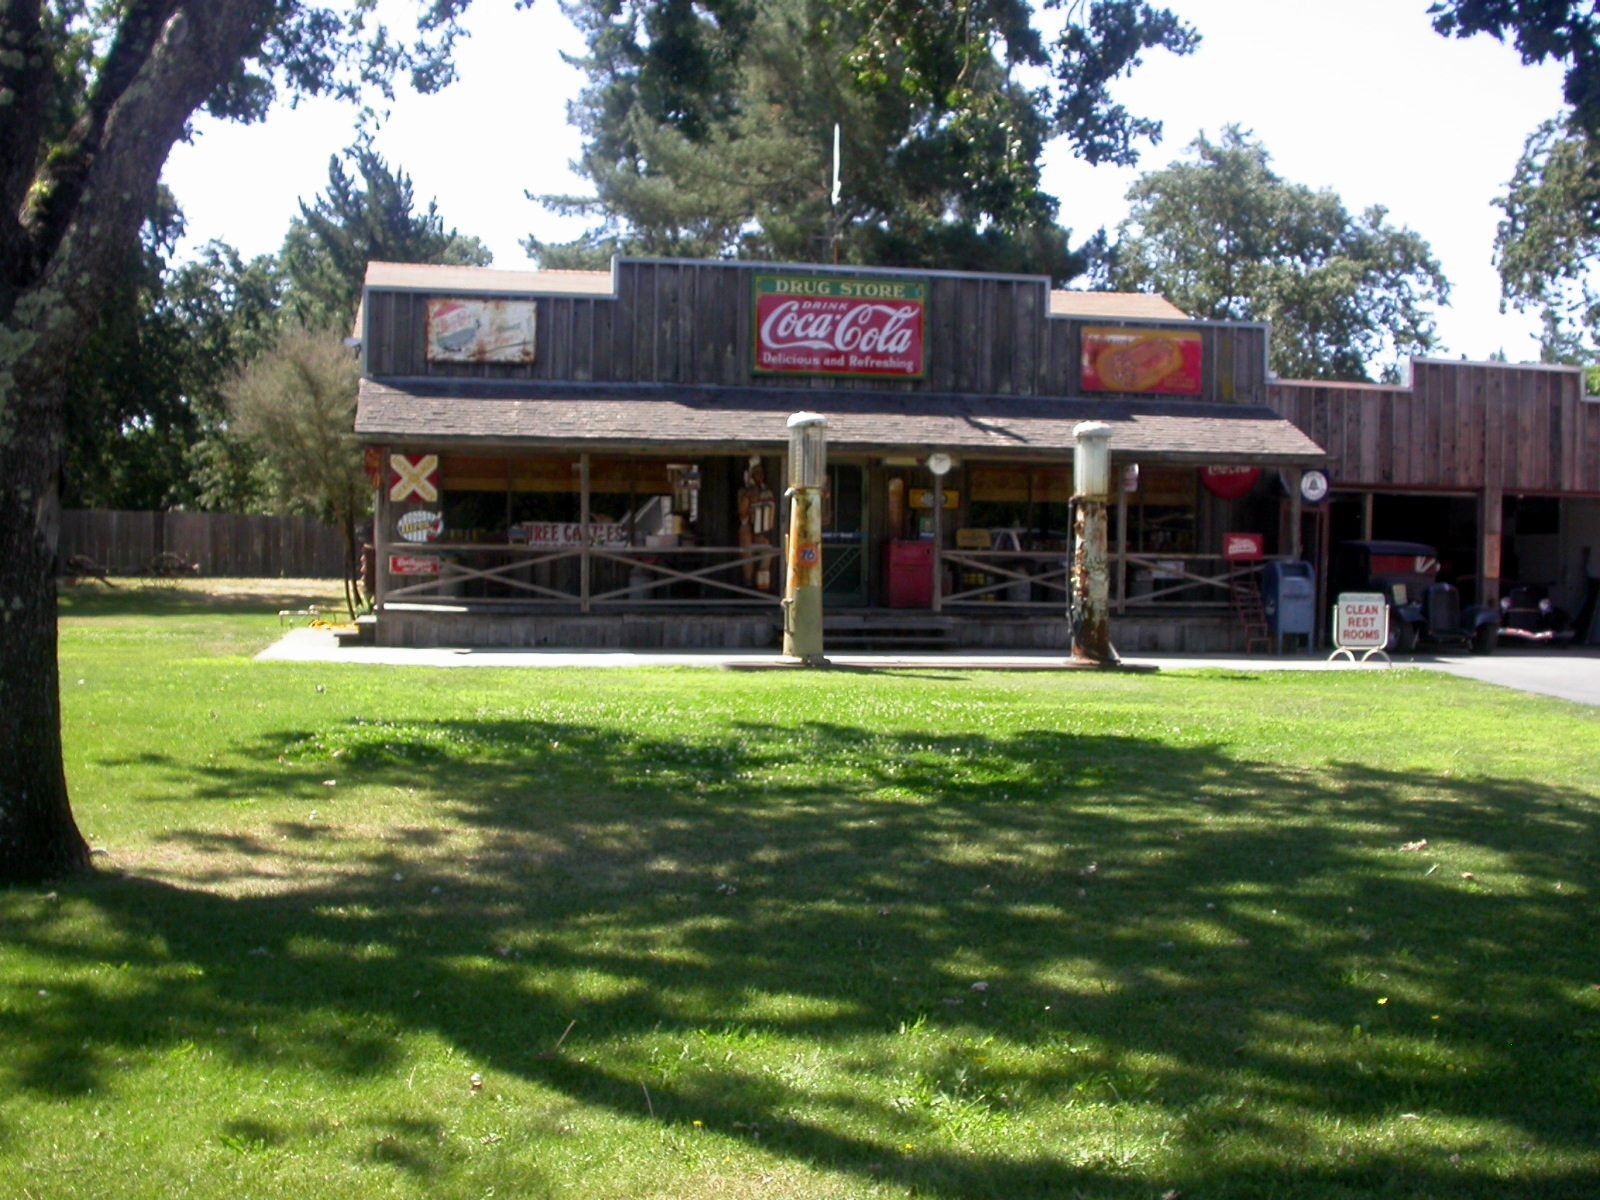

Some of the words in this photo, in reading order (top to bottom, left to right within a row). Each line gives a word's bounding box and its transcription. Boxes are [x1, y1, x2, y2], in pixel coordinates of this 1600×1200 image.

[775, 280, 831, 294] DRUG
[840, 282, 906, 298] STORE
[802, 302, 849, 311] DRINK
[763, 353, 820, 366] Delicious
[823, 354, 845, 367] and
[849, 355, 914, 373] Refreshing
[1345, 604, 1379, 615] CLEAN
[1347, 617, 1375, 628] REST
[1343, 630, 1380, 640] ROOMS
